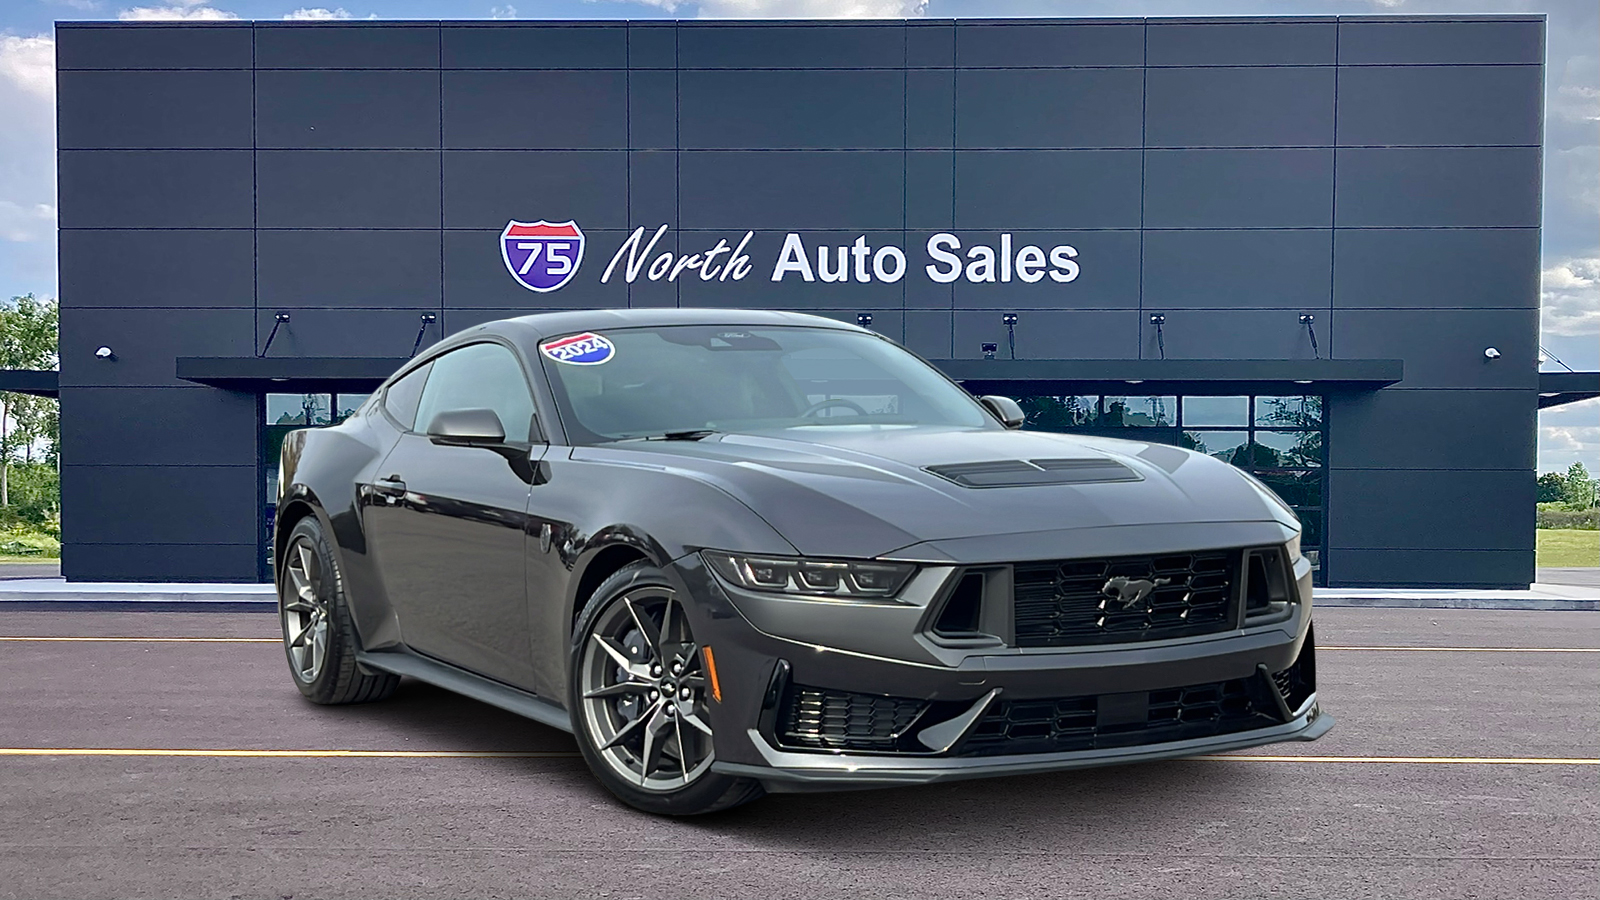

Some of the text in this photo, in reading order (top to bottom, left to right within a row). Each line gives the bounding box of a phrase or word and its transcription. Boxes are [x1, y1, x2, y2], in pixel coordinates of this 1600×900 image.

[517, 224, 1080, 284] 75 North Auto Sales
[551, 337, 609, 360] 2024
